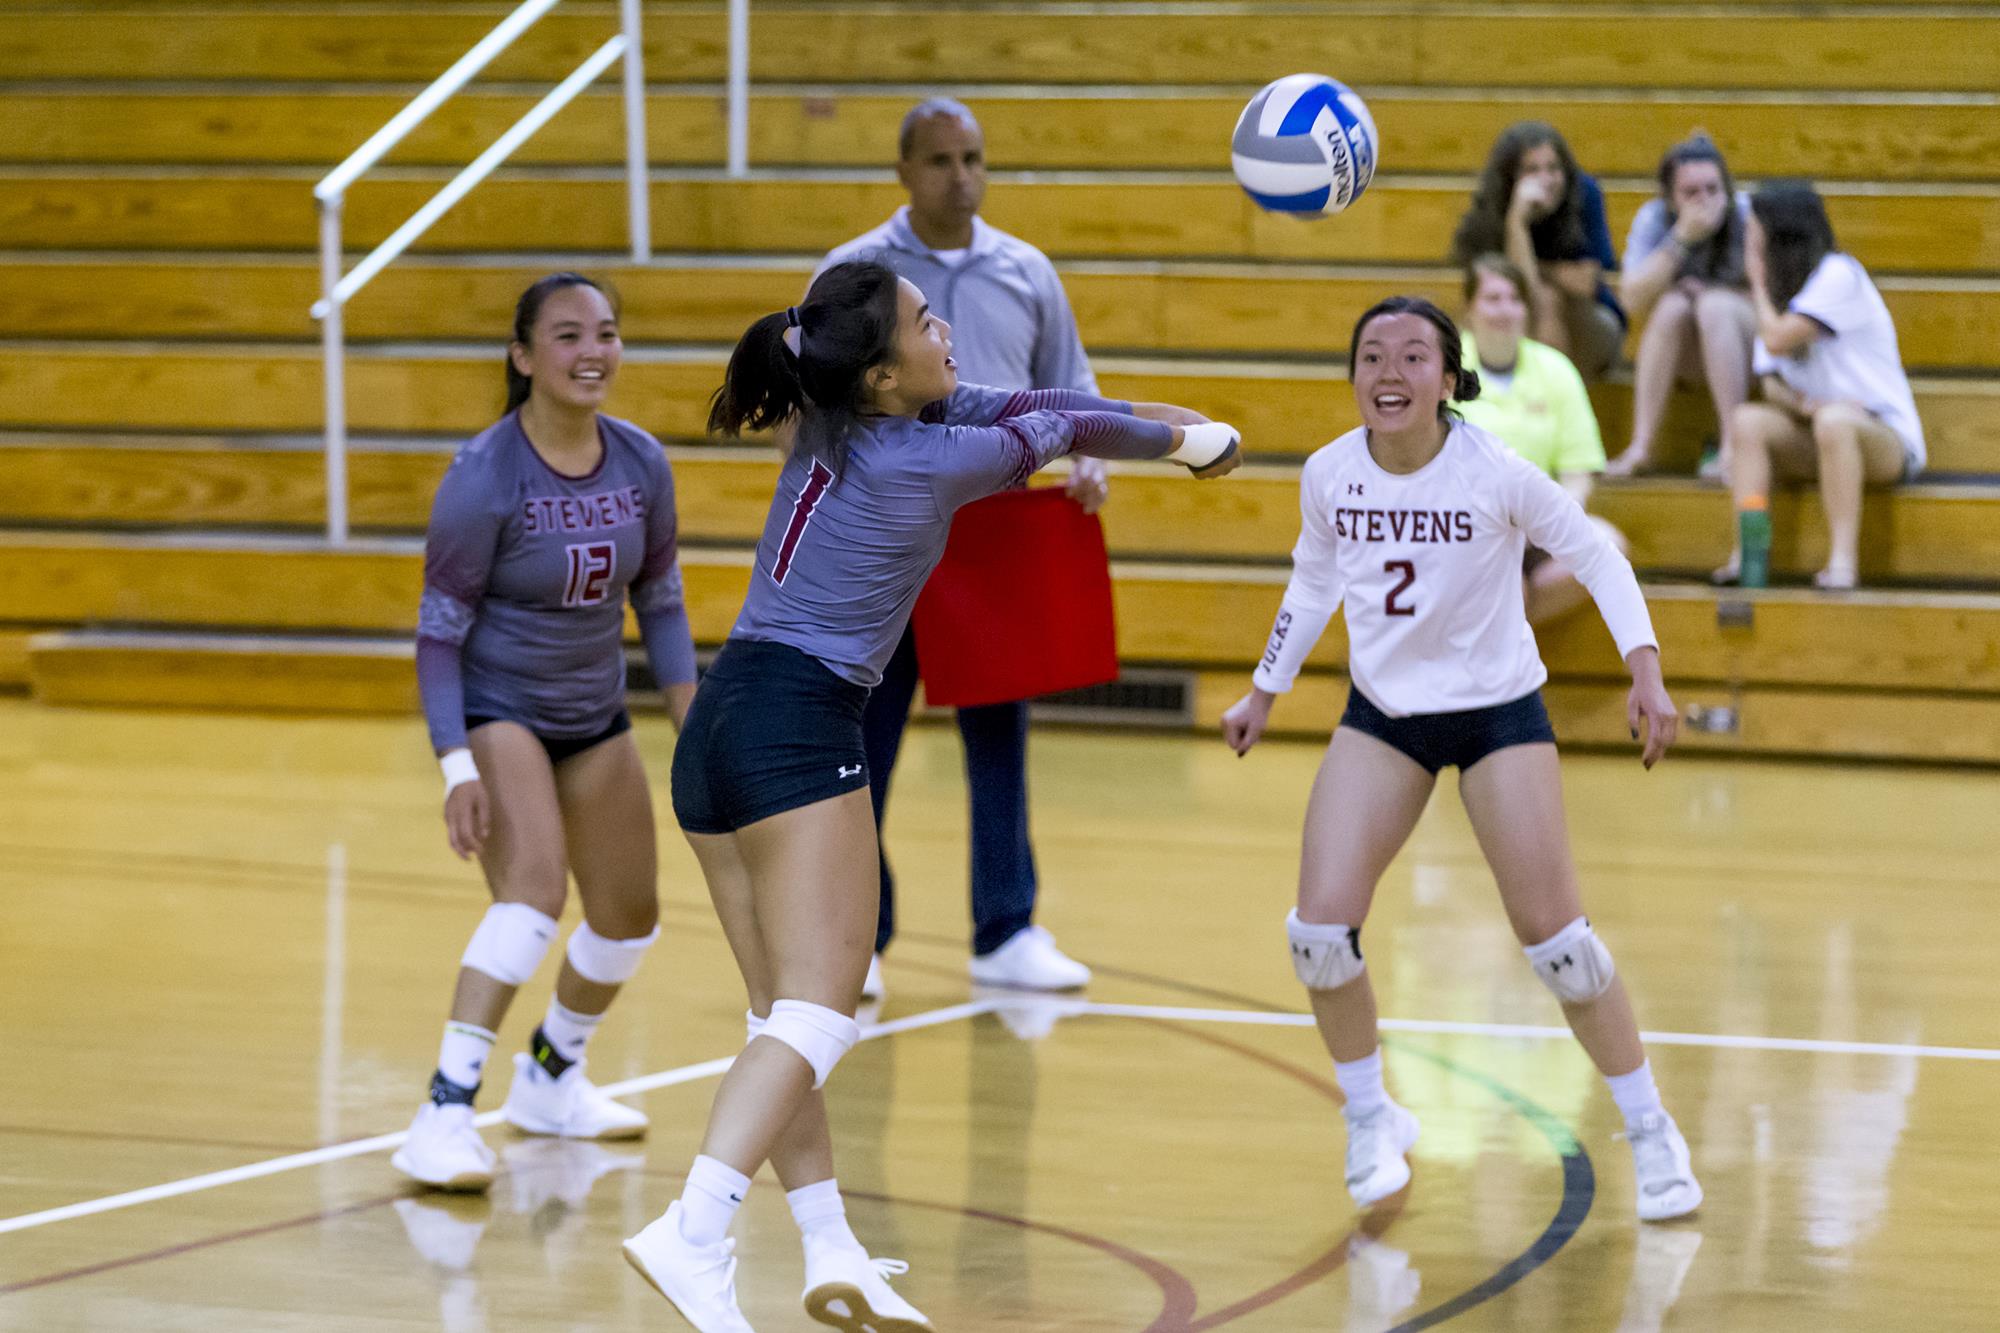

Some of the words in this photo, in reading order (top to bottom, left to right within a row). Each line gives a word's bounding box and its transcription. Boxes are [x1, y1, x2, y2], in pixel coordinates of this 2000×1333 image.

[523, 485, 645, 535] STEVENS
[771, 455, 836, 588] 1
[1335, 508, 1473, 543] STEVENS
[562, 540, 617, 608] 12
[1383, 559, 1417, 617] 2
